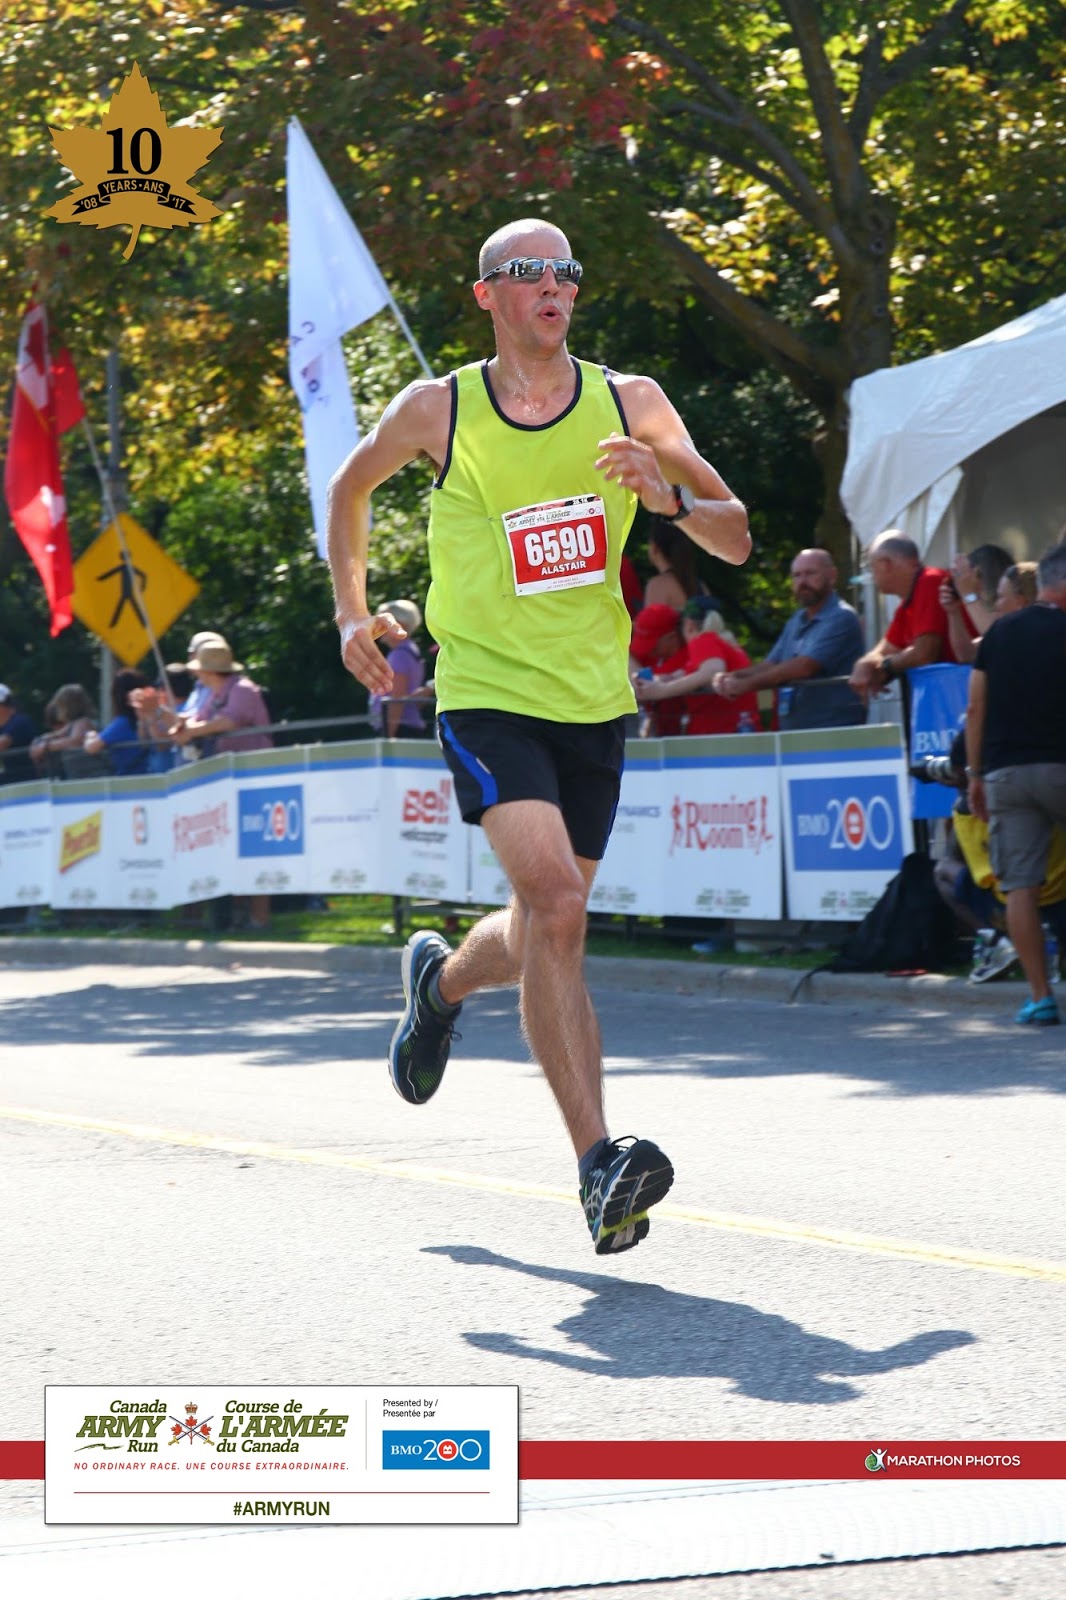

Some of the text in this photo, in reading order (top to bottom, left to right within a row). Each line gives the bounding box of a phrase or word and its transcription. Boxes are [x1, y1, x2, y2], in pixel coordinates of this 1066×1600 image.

[524, 523, 595, 567] 6590
[541, 560, 586, 576] ALASTAIR
[684, 795, 757, 832] Running
[797, 814, 830, 837] BMO
[684, 818, 744, 851] Room
